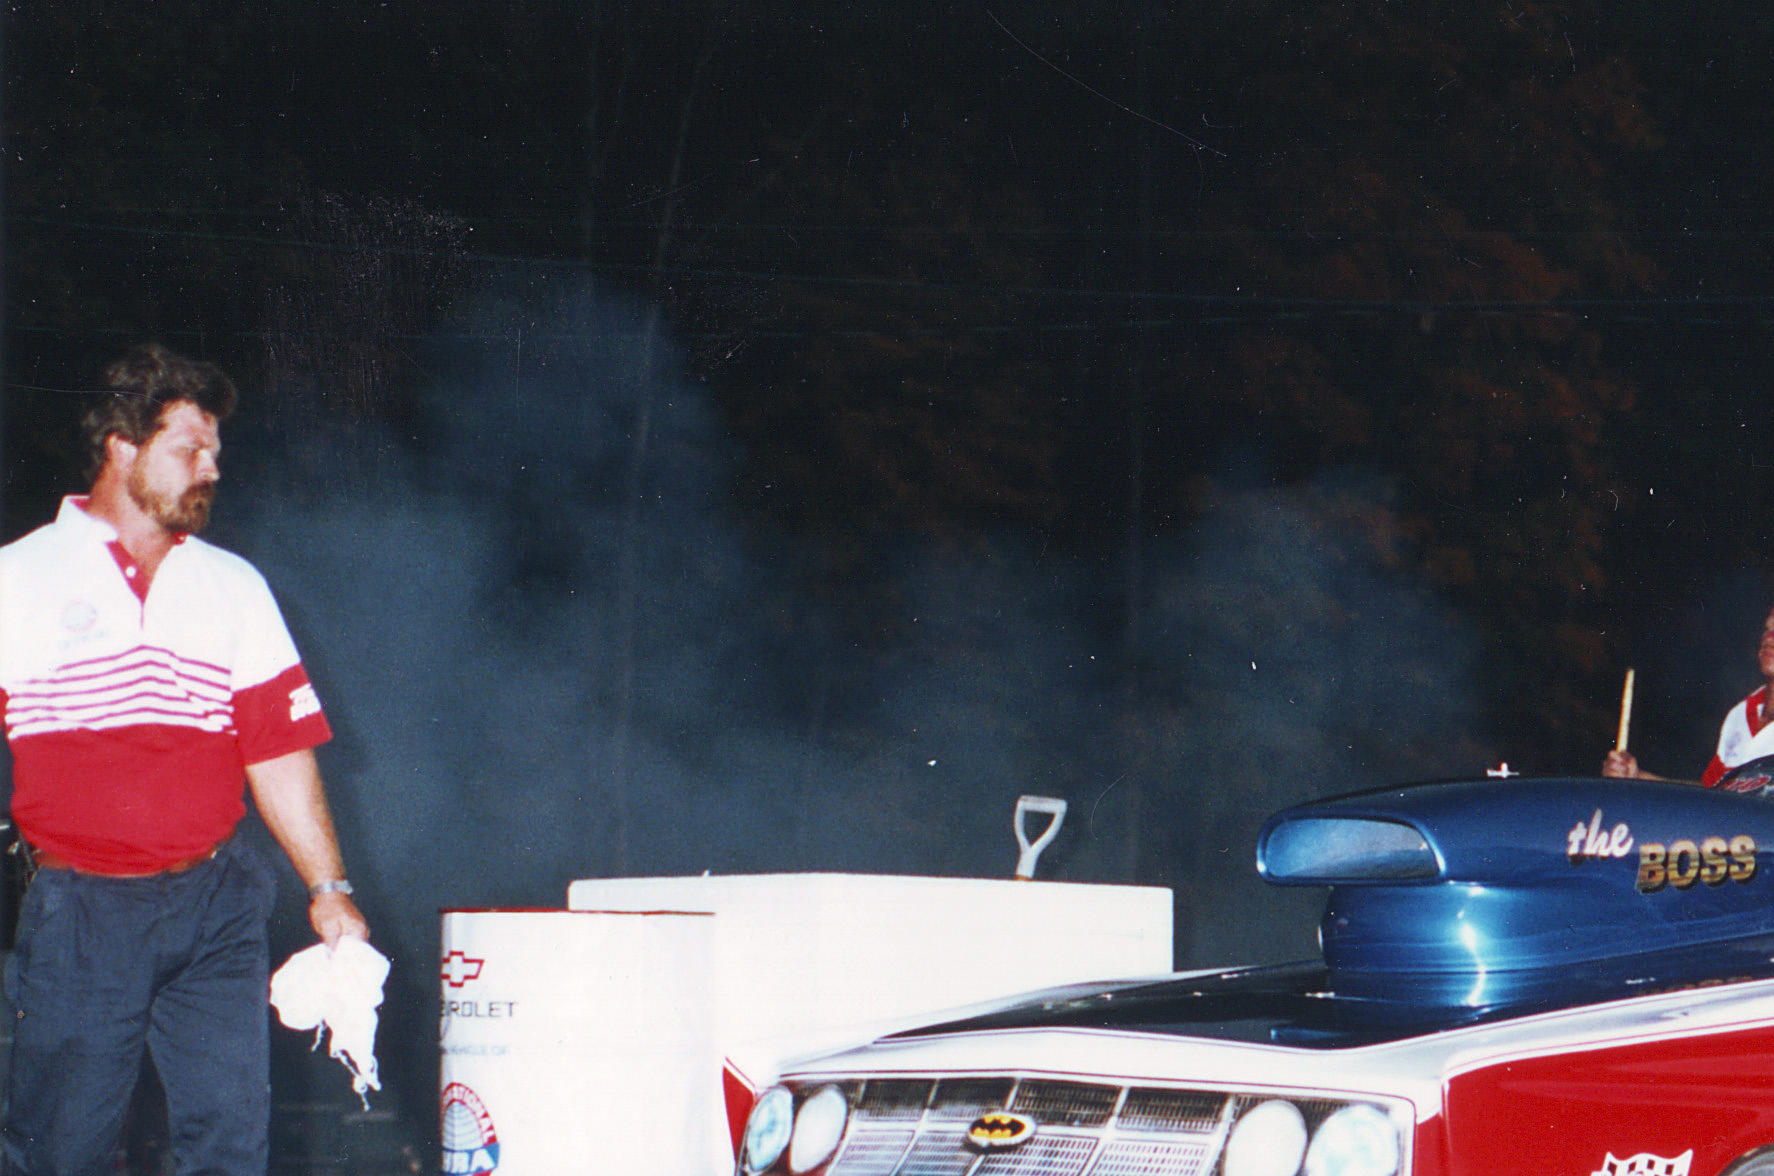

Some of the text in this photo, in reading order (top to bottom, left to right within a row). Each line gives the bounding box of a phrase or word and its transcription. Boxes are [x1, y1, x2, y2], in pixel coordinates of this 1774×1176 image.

[1567, 808, 1758, 893] the BOSS
[441, 1000, 519, 1017] ROLET
